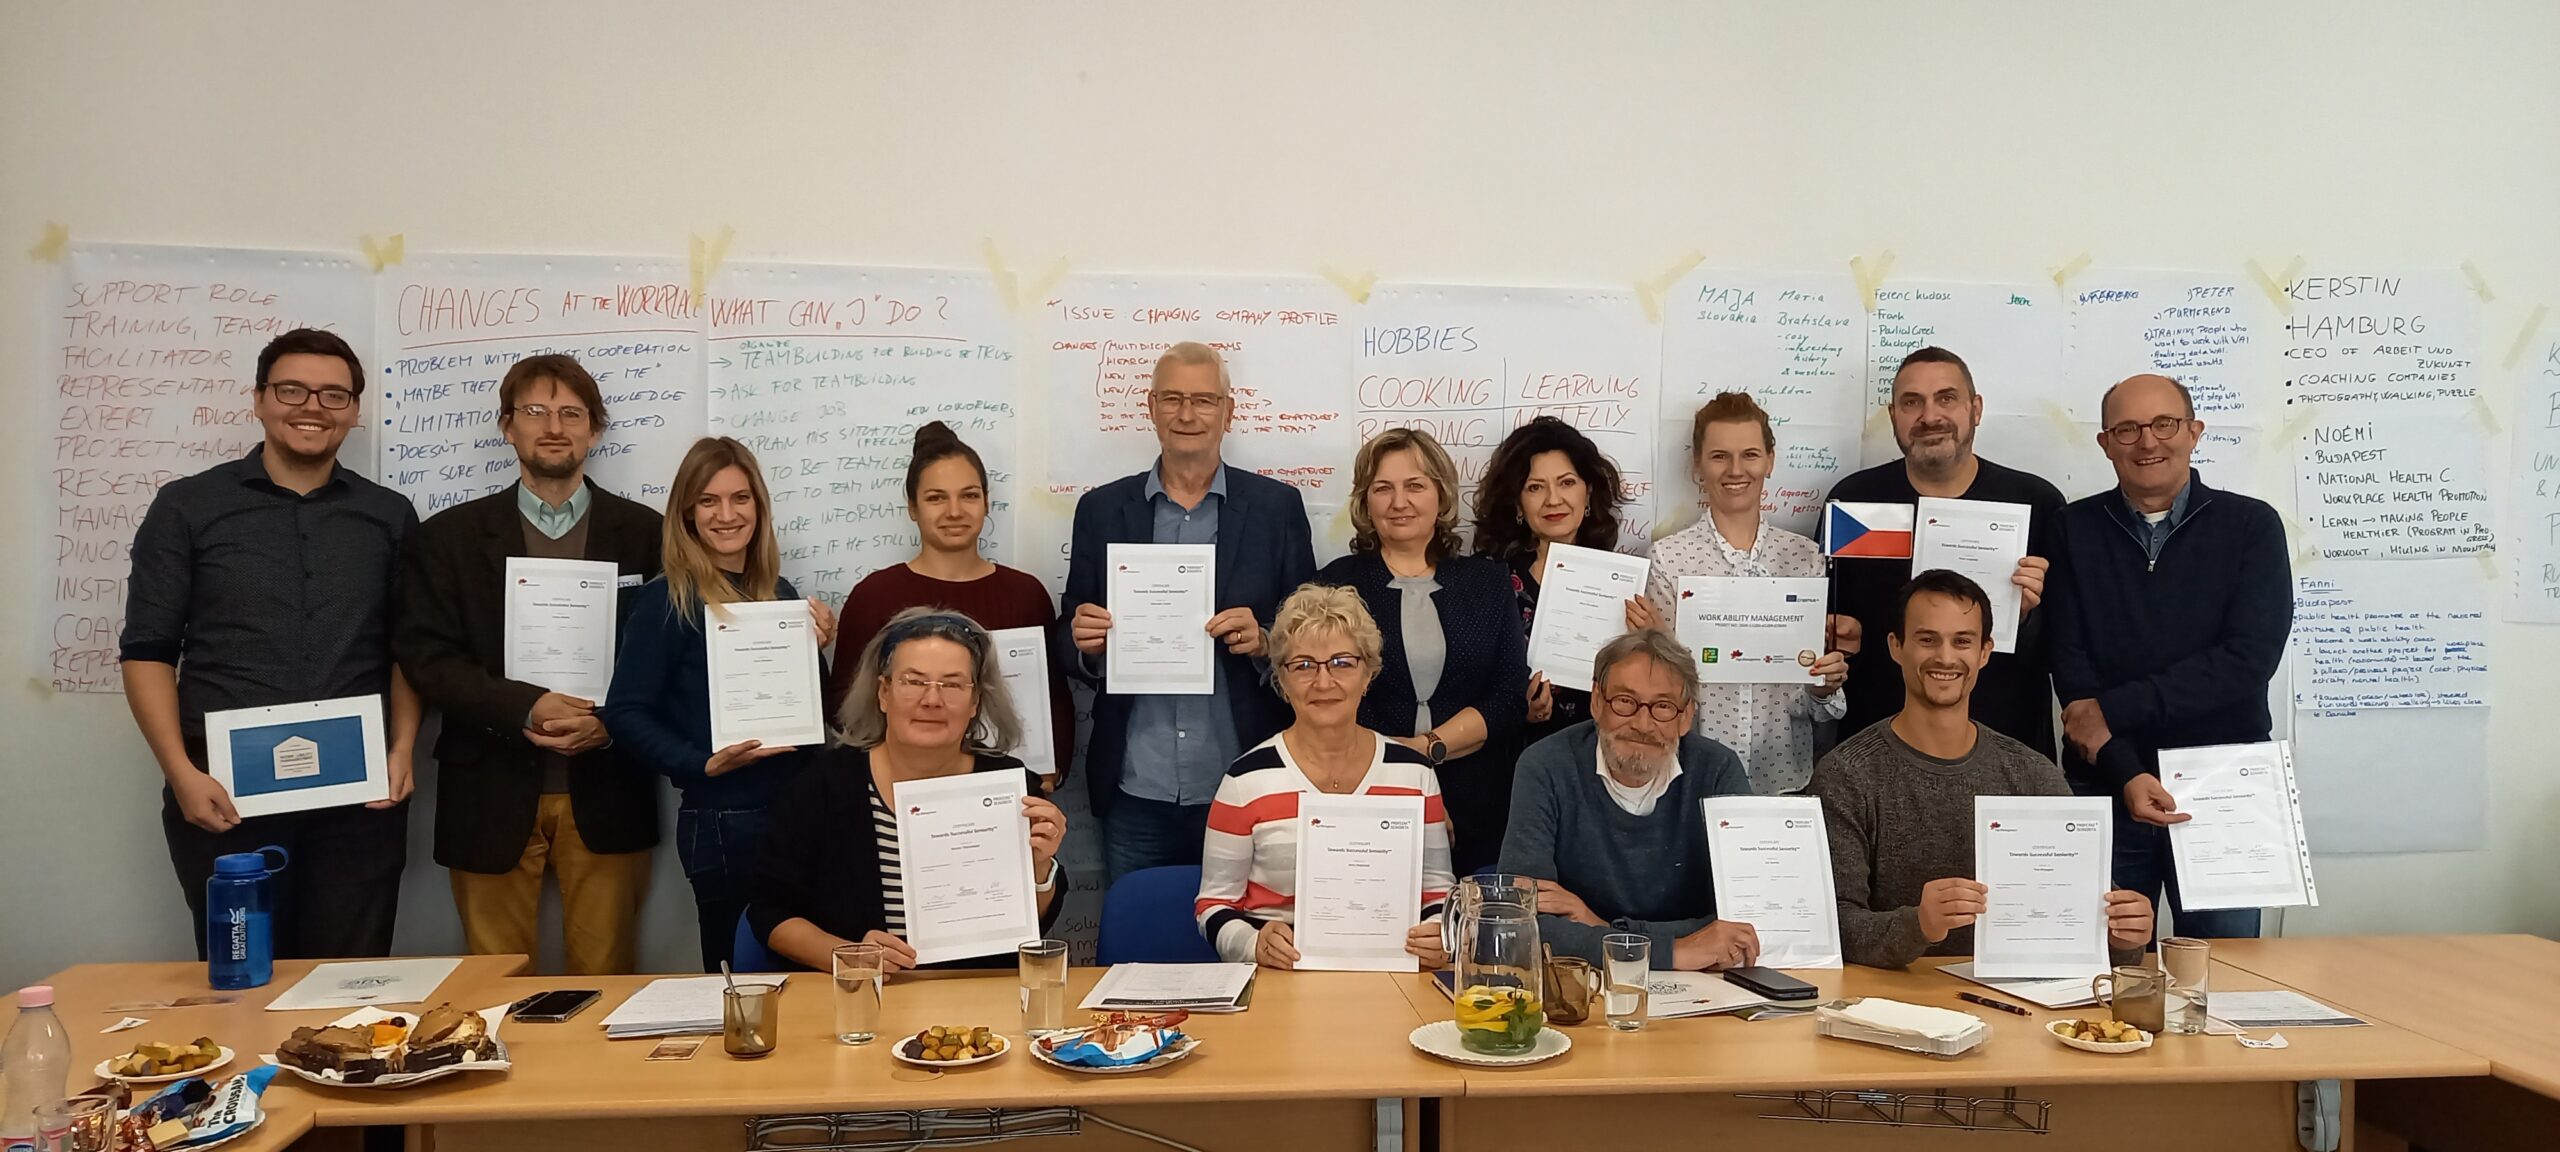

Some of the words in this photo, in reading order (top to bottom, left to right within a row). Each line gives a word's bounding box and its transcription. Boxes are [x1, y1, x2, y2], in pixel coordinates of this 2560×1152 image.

[65, 281, 200, 308] SUPPORT
[208, 283, 279, 307] ROLE
[1698, 284, 1756, 311] MAJA
[1875, 288, 1910, 301] Ferenc
[2289, 276, 2401, 301] KERSTIN
[398, 284, 542, 336] CHANGES
[562, 291, 587, 317] AT
[710, 297, 780, 328] WHAT
[788, 299, 836, 327] CAN
[886, 299, 921, 325] DO
[1064, 306, 1115, 320] ISSUE
[1277, 310, 1339, 326] PROFILE
[1777, 311, 1850, 328] Bratislava
[2291, 314, 2427, 341] HAMBURG
[1363, 326, 1479, 358] HOBBIES
[61, 345, 232, 370] FACILITATOR
[396, 355, 473, 378] PROBLEM
[484, 351, 521, 366] WITH
[588, 343, 691, 358] COOPERATION
[2289, 348, 2327, 359] CEO
[2373, 345, 2422, 355] ARBEIT
[2427, 346, 2453, 355] UND
[2417, 358, 2472, 369] ZUKUNFT
[461, 379, 498, 395] THEY
[2299, 373, 2377, 386] COACHING
[2387, 372, 2457, 383] COMPANIES
[730, 382, 758, 400] ASK
[771, 379, 802, 394] FOR
[1358, 375, 1493, 409] COOKING
[1520, 373, 1640, 400] LEARNING
[2436, 388, 2477, 398] PUZZLE
[59, 405, 154, 432] EXPERT
[2315, 449, 2388, 465] BUDAPEST
[53, 469, 180, 497] RESEAR
[398, 470, 430, 485] NOT
[439, 466, 473, 482] SURE
[2318, 471, 2380, 485] NATIONAL
[2389, 470, 2433, 483] HEALTH
[2322, 493, 2385, 505] WORKPLACE
[2392, 490, 2433, 503] HEALTH
[2321, 514, 2358, 528] LEARN
[2380, 512, 2424, 524] MAKING
[2431, 509, 2469, 522] PEOPLE
[873, 534, 905, 547] STILL
[2343, 527, 2400, 540] HEALTHIER
[2323, 547, 2369, 559] WORKOUT
[1723, 614, 1750, 622] ABILITY
[232, 925, 240, 960] REGATTA
